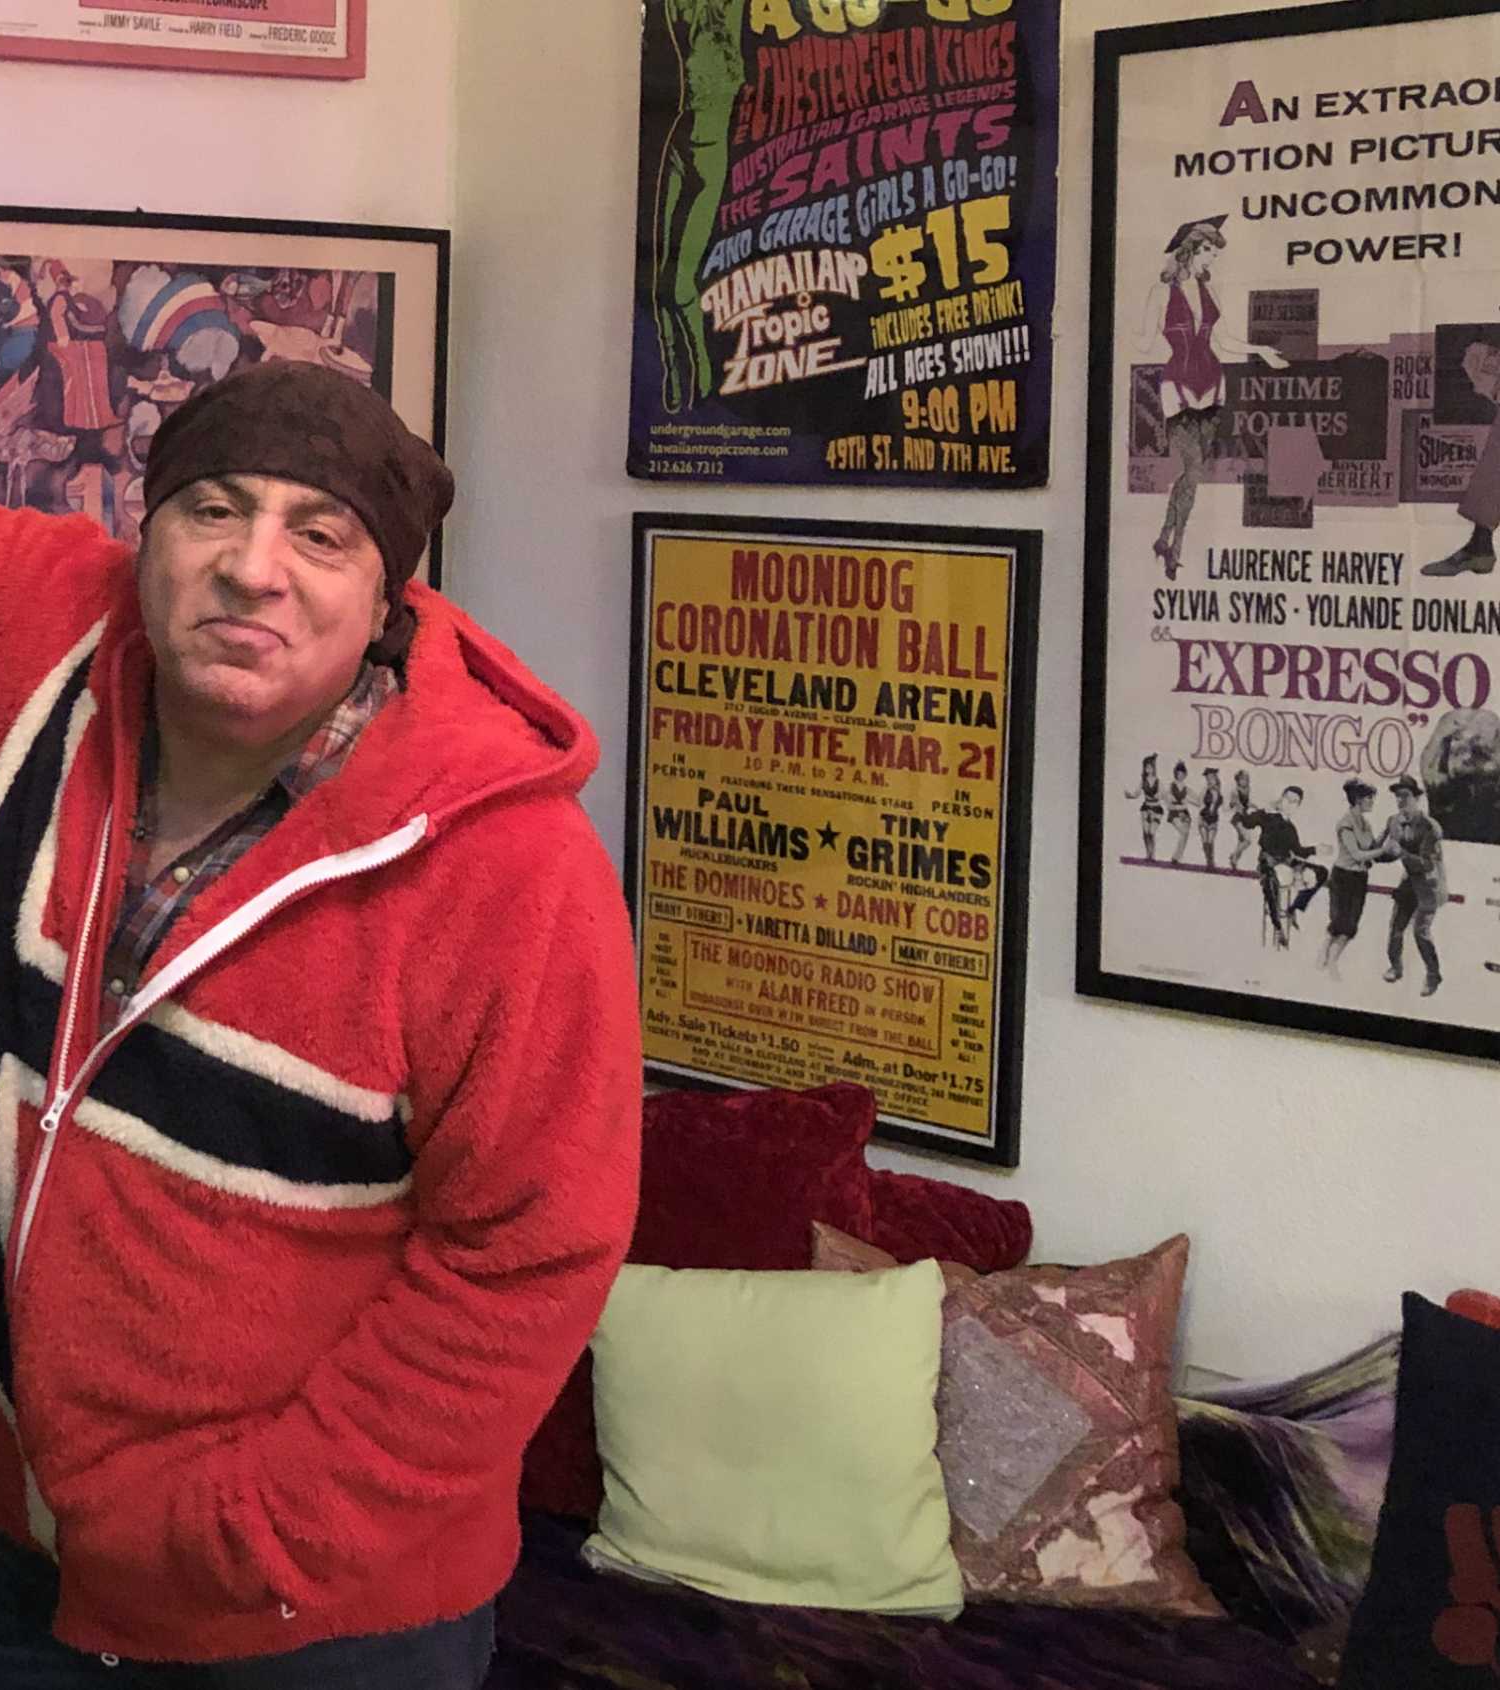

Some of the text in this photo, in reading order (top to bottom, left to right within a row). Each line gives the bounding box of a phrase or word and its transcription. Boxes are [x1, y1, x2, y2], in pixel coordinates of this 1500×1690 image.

[103, 14, 130, 29] JIMMY
[133, 17, 161, 32] SAVILE
[190, 22, 243, 38] HARRY FIELD
[268, 27, 307, 43] FREDERIC
[848, 96, 930, 138] GARAGE
[934, 80, 1017, 110] LEGENDS
[1316, 77, 1500, 119] EXTRAO
[720, 104, 1017, 231] THE SAINTS
[1174, 141, 1333, 178] MOTION
[759, 195, 852, 257] GARAGE
[923, 168, 937, 208] A
[943, 156, 1017, 199] GO-GO!
[1242, 179, 1500, 221] UNCOMMON
[871, 195, 1010, 303] $15
[1287, 232, 1461, 267] POWER!
[700, 249, 869, 333] HAWAIIAN
[723, 292, 831, 361] Tropic
[937, 296, 969, 340] FREE
[864, 356, 898, 400] ALL
[905, 344, 947, 385] AGES
[1393, 354, 1433, 375] ROCK
[902, 380, 1017, 433] 9:00 PM
[1239, 375, 1342, 400] INTIME
[1392, 378, 1430, 400] ROLL
[649, 441, 789, 459] hawaiiantropiczone.com
[650, 423, 791, 439] undergroundgarage.com
[826, 436, 1016, 474] 49TH ST. AND 7TH AVE.
[731, 550, 914, 613] MOONDOG
[1207, 547, 1404, 586] LAURENCE HARVEY
[1152, 588, 1500, 635] SYLVIA SYMS YOLANDE DONLAN
[655, 602, 998, 682] CORONATION BALL
[655, 660, 997, 730] CLEVELAND ARENA
[652, 707, 996, 780] FRIDAY NITE, MAR. 21
[653, 764, 706, 781] PERSON
[744, 756, 763, 770] 10
[812, 764, 826, 780] to
[834, 767, 844, 781] 2
[698, 788, 769, 818] PAUL
[932, 801, 994, 820] PERSON
[954, 789, 970, 802] IN
[652, 806, 809, 861] WILLIAMS
[880, 813, 949, 842] TINY
[846, 835, 992, 889] GRIMES
[650, 860, 989, 942] THE DOMINOES DANNY COBB
[745, 916, 878, 956] VARETTA DILLARD
[690, 939, 936, 1005] THE MOONDOG RADIO SHOW
[758, 979, 802, 1006] ALAN
[806, 987, 860, 1017] FREED
[843, 1051, 879, 1070] Adm.
[883, 1062, 898, 1074] at
[903, 1063, 938, 1083] Door
[942, 1071, 984, 1093] $1.75
